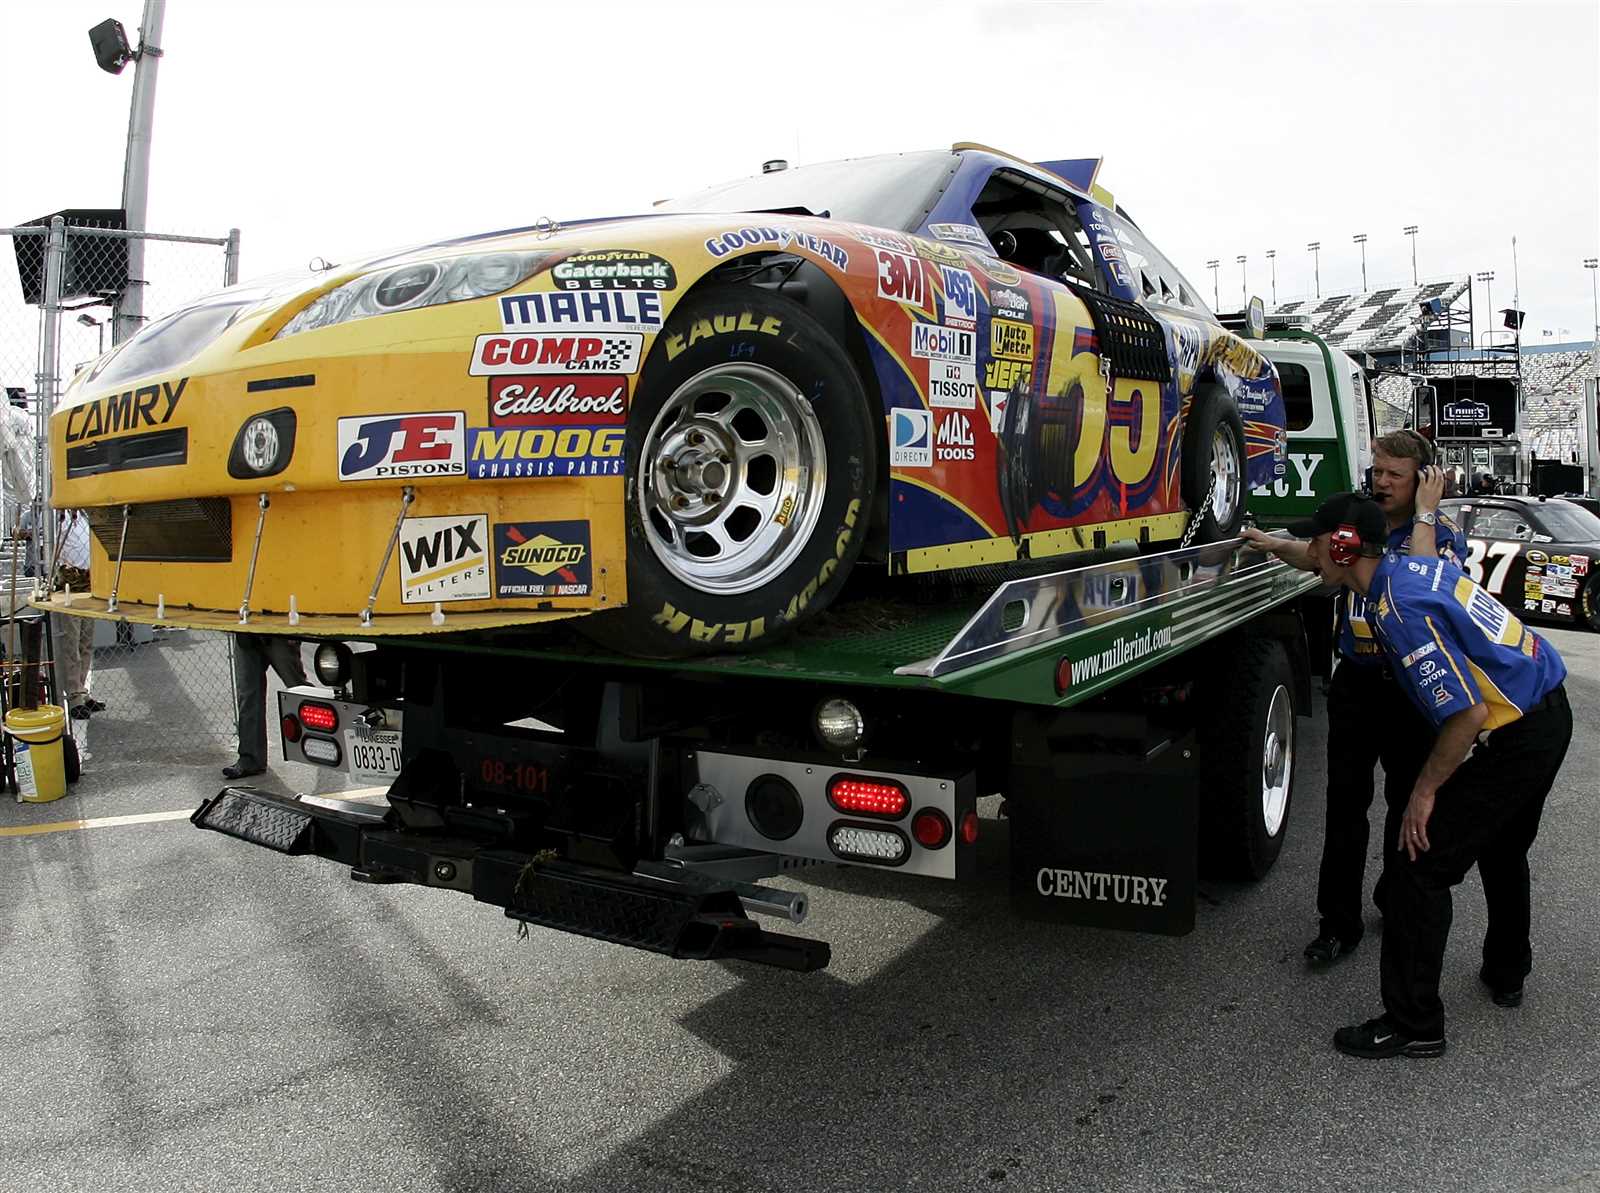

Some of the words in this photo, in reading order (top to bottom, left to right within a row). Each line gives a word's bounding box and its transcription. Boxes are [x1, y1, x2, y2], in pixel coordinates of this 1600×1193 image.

[567, 252, 650, 262] GOODYEAR
[704, 227, 850, 273] GOODYEAR
[553, 261, 669, 278] Gatorback
[565, 279, 667, 289] BELTS
[879, 251, 922, 304] 3M
[501, 291, 661, 325] MAHLE
[942, 268, 975, 317] USG
[998, 309, 1025, 320] POLE
[665, 312, 782, 362] EAGLE
[915, 325, 956, 354] Mobil
[961, 334, 970, 356] 1
[1003, 339, 1032, 355] Meter
[1004, 326, 1027, 341] Auto
[481, 338, 603, 366] COMP
[565, 359, 622, 370] CAMS
[493, 384, 624, 416] Edelbrock
[931, 380, 975, 398] TISSOT
[1043, 290, 1160, 487] 55
[65, 377, 189, 443] CAMRY
[471, 428, 625, 461] MOOG
[937, 412, 974, 446] MAC
[340, 416, 456, 476] JE
[895, 451, 928, 462] DIRECTV
[937, 448, 975, 460] TOOLS
[376, 462, 464, 476] PISTONS
[478, 462, 554, 478] CHASSIS
[568, 460, 620, 475] PARTS
[402, 520, 482, 574] WIX
[504, 547, 582, 565] SUNOCO
[1464, 540, 1520, 594] 37
[406, 567, 485, 600] FILTERS
[500, 585, 528, 594] OFFICIAL
[529, 585, 544, 594] FUEL
[557, 584, 587, 595] NASCAR
[1071, 626, 1172, 686] www.millerind.com
[1419, 668, 1448, 689] TOYOTA
[354, 745, 401, 771] 0833-D
[481, 759, 551, 792] 08-101
[1037, 868, 1168, 906] CENTURY
